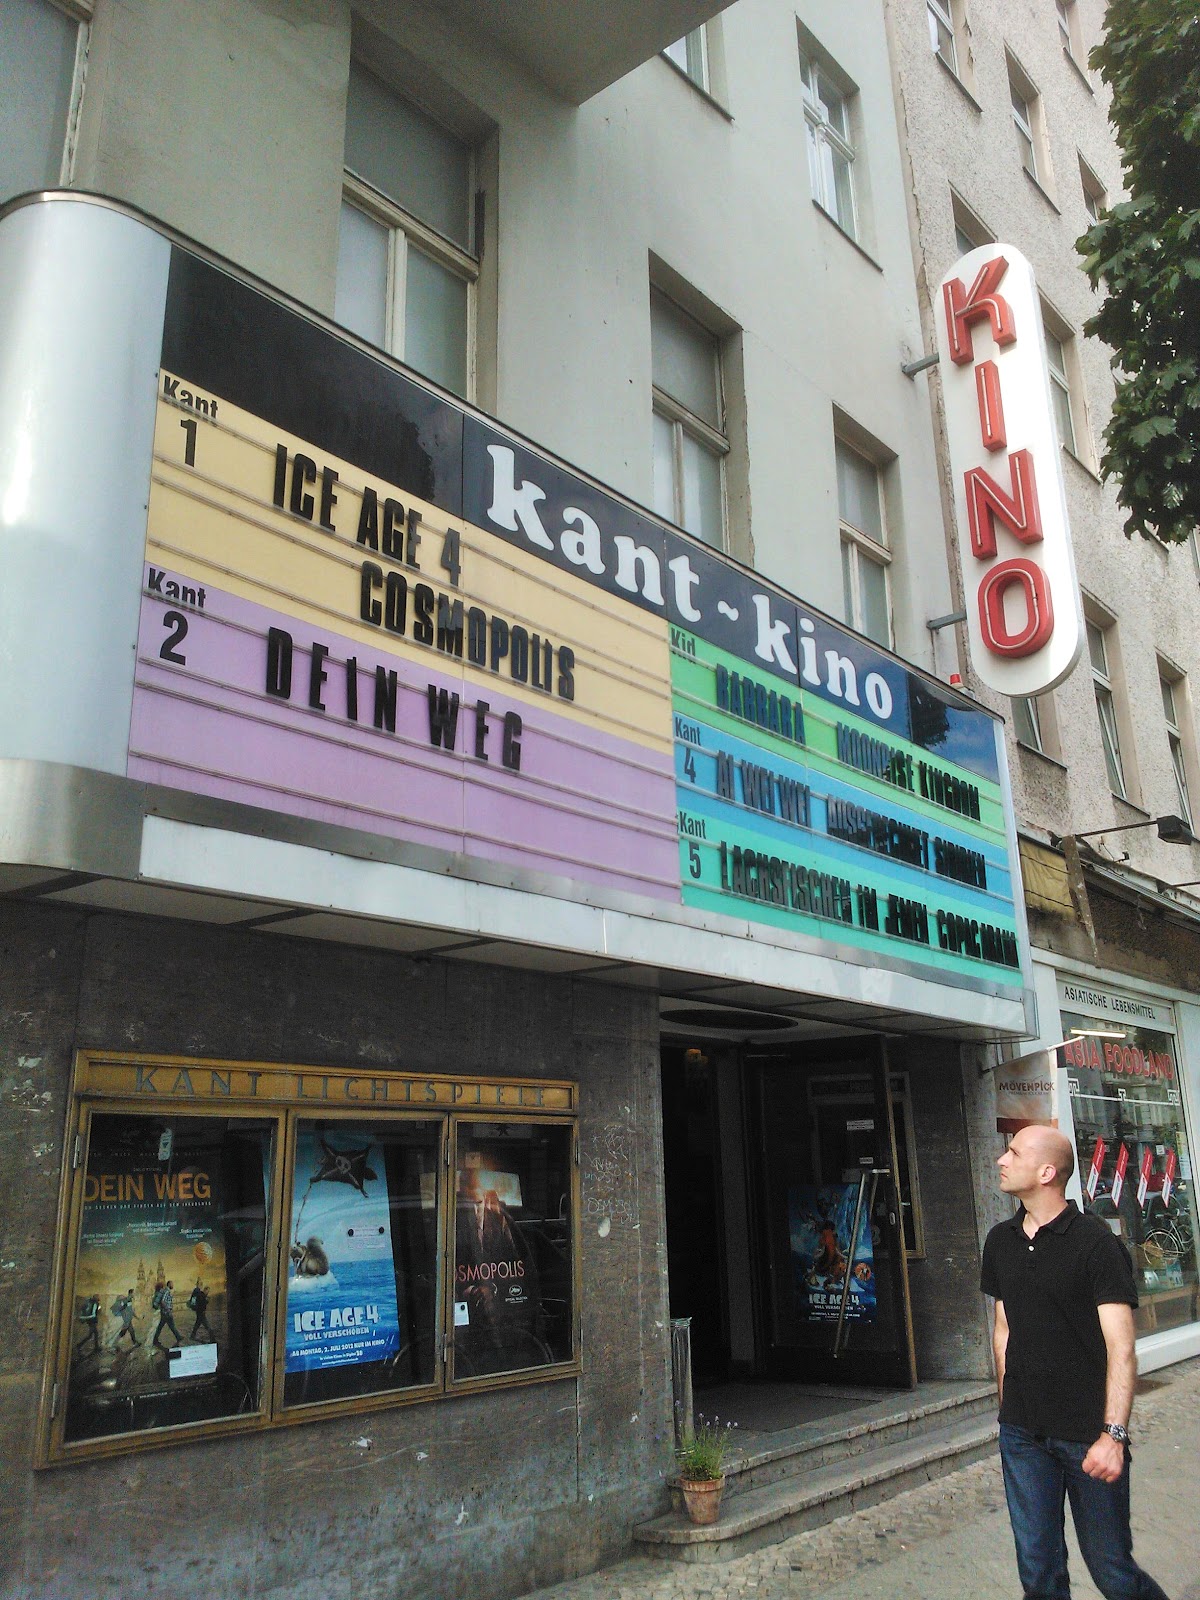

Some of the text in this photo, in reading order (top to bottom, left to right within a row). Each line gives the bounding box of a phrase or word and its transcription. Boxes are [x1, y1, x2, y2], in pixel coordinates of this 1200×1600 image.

[164, 375, 218, 421] Kant
[180, 418, 198, 467] 1
[942, 255, 1054, 658] KINO
[273, 443, 463, 586] ICE AGE 4
[149, 567, 206, 609] Kant
[486, 444, 702, 623] kant
[752, 594, 893, 719] kino
[159, 610, 189, 666] 2
[360, 560, 576, 701] COSMOPOLIS
[266, 626, 523, 771] DEIN WEG
[717, 663, 806, 745] BARBARA
[675, 717, 702, 747] Kant
[684, 747, 696, 783] 4
[679, 811, 707, 840] Kant
[689, 841, 702, 879] 5
[720, 840, 853, 924] LACHSFISCHEN
[1064, 986, 1156, 1019] ASIATISCHE LEBENSMITTEL
[1063, 1035, 1174, 1080] ASIA FOODLAND
[135, 1065, 262, 1097] KANT
[84, 1171, 211, 1202] DEIN WEG
[294, 1304, 379, 1332] ICE AGE 4
[304, 1327, 369, 1341] VOLL VERSCHOBEN
